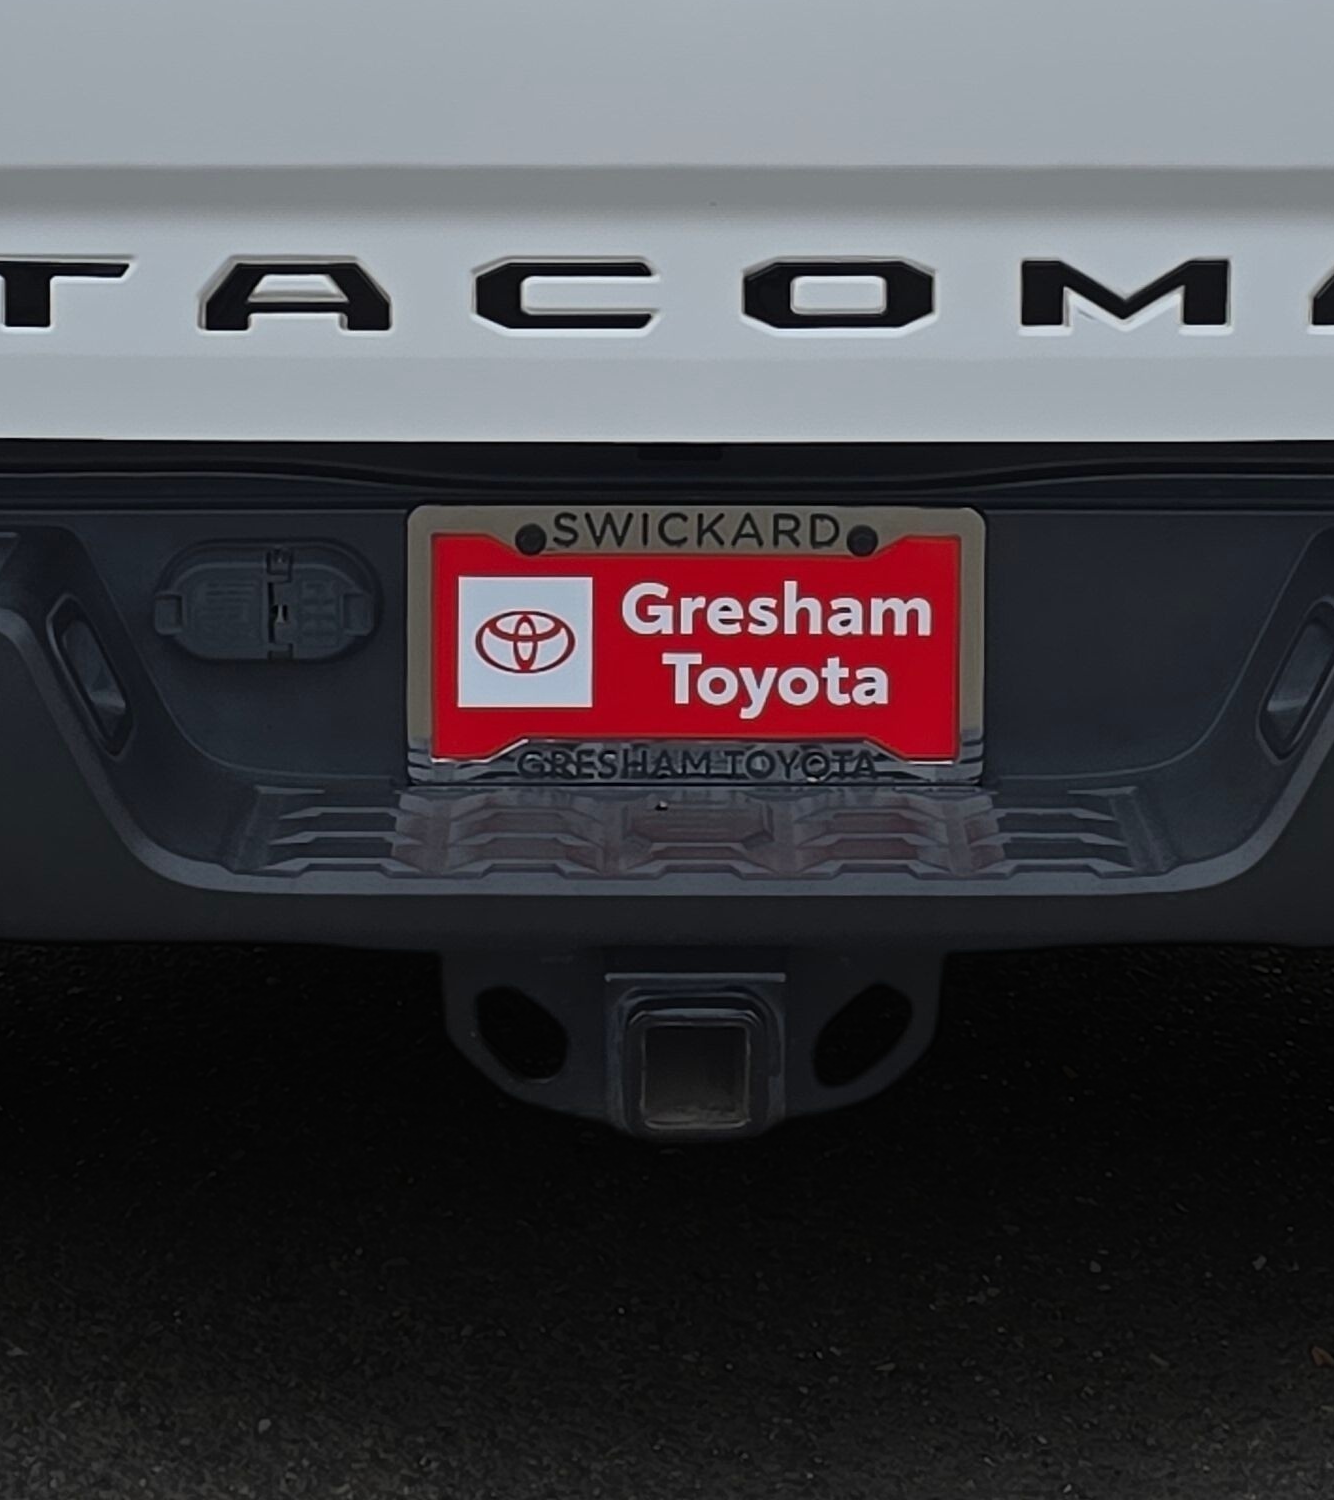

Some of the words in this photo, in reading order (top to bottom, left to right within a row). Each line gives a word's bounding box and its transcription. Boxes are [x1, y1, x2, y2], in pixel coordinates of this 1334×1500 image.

[552, 512, 840, 547] SWICKARD
[622, 581, 931, 636] Gresham
[662, 652, 888, 719] Toyota
[517, 750, 713, 780] GRESHAM
[724, 750, 877, 780] TOYOTA
